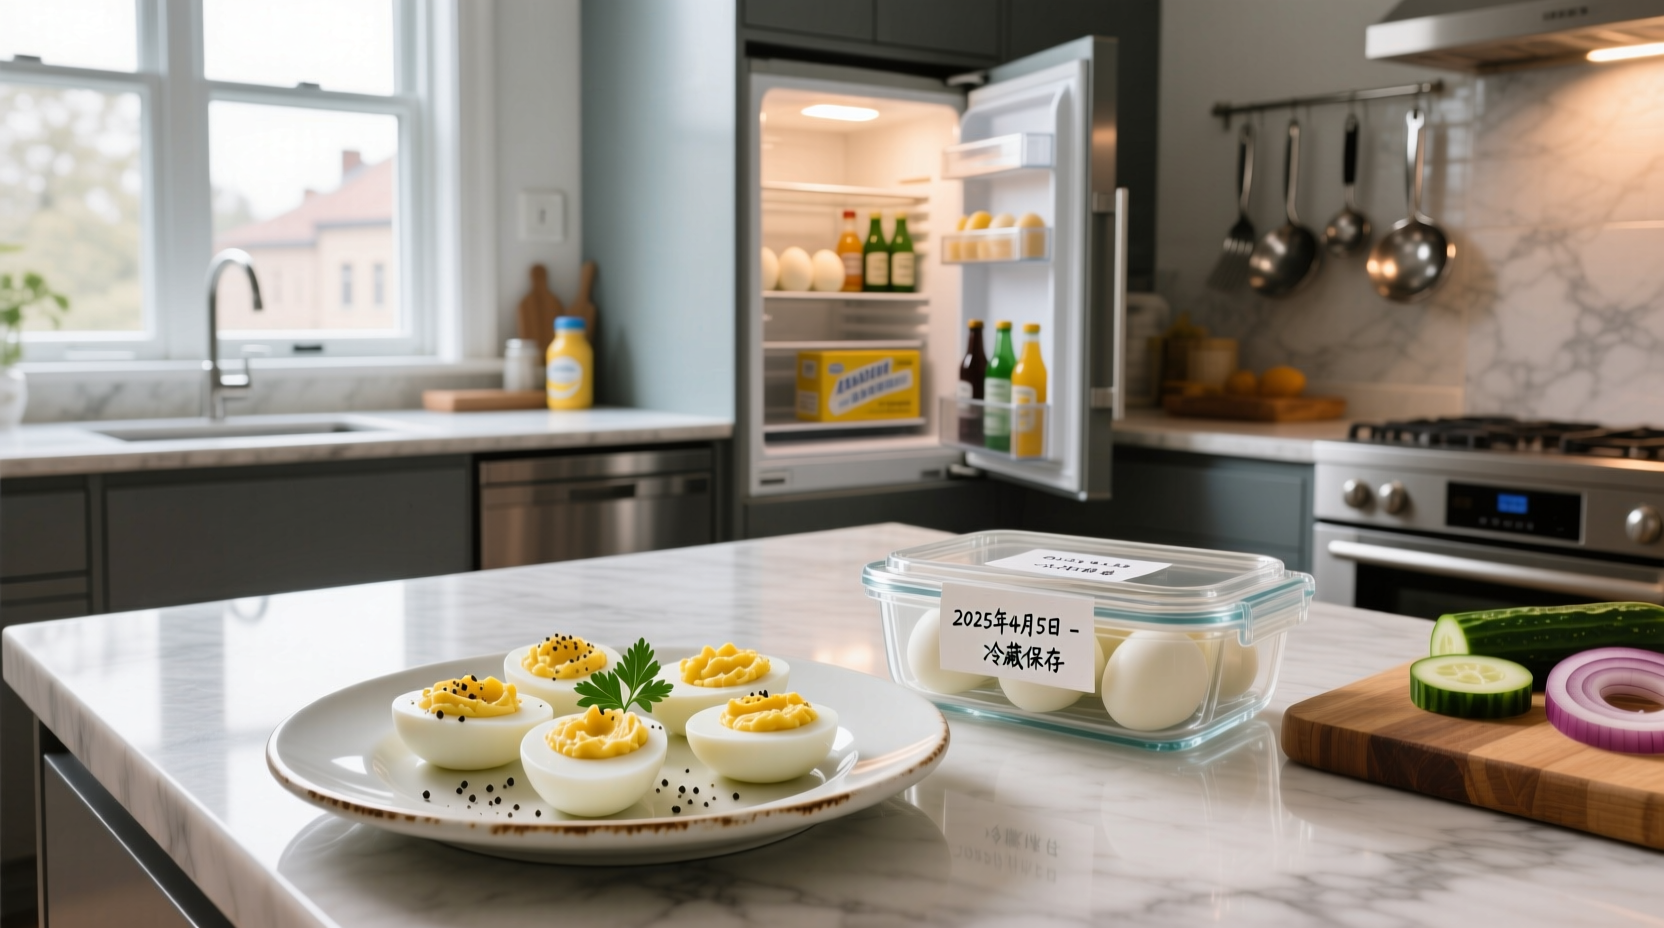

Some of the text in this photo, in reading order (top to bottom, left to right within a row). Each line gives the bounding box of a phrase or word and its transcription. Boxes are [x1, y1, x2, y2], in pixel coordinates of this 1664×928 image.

[952, 607, 1060, 637] 2025年4月5日
[983, 641, 1065, 674] 冷藏保存
